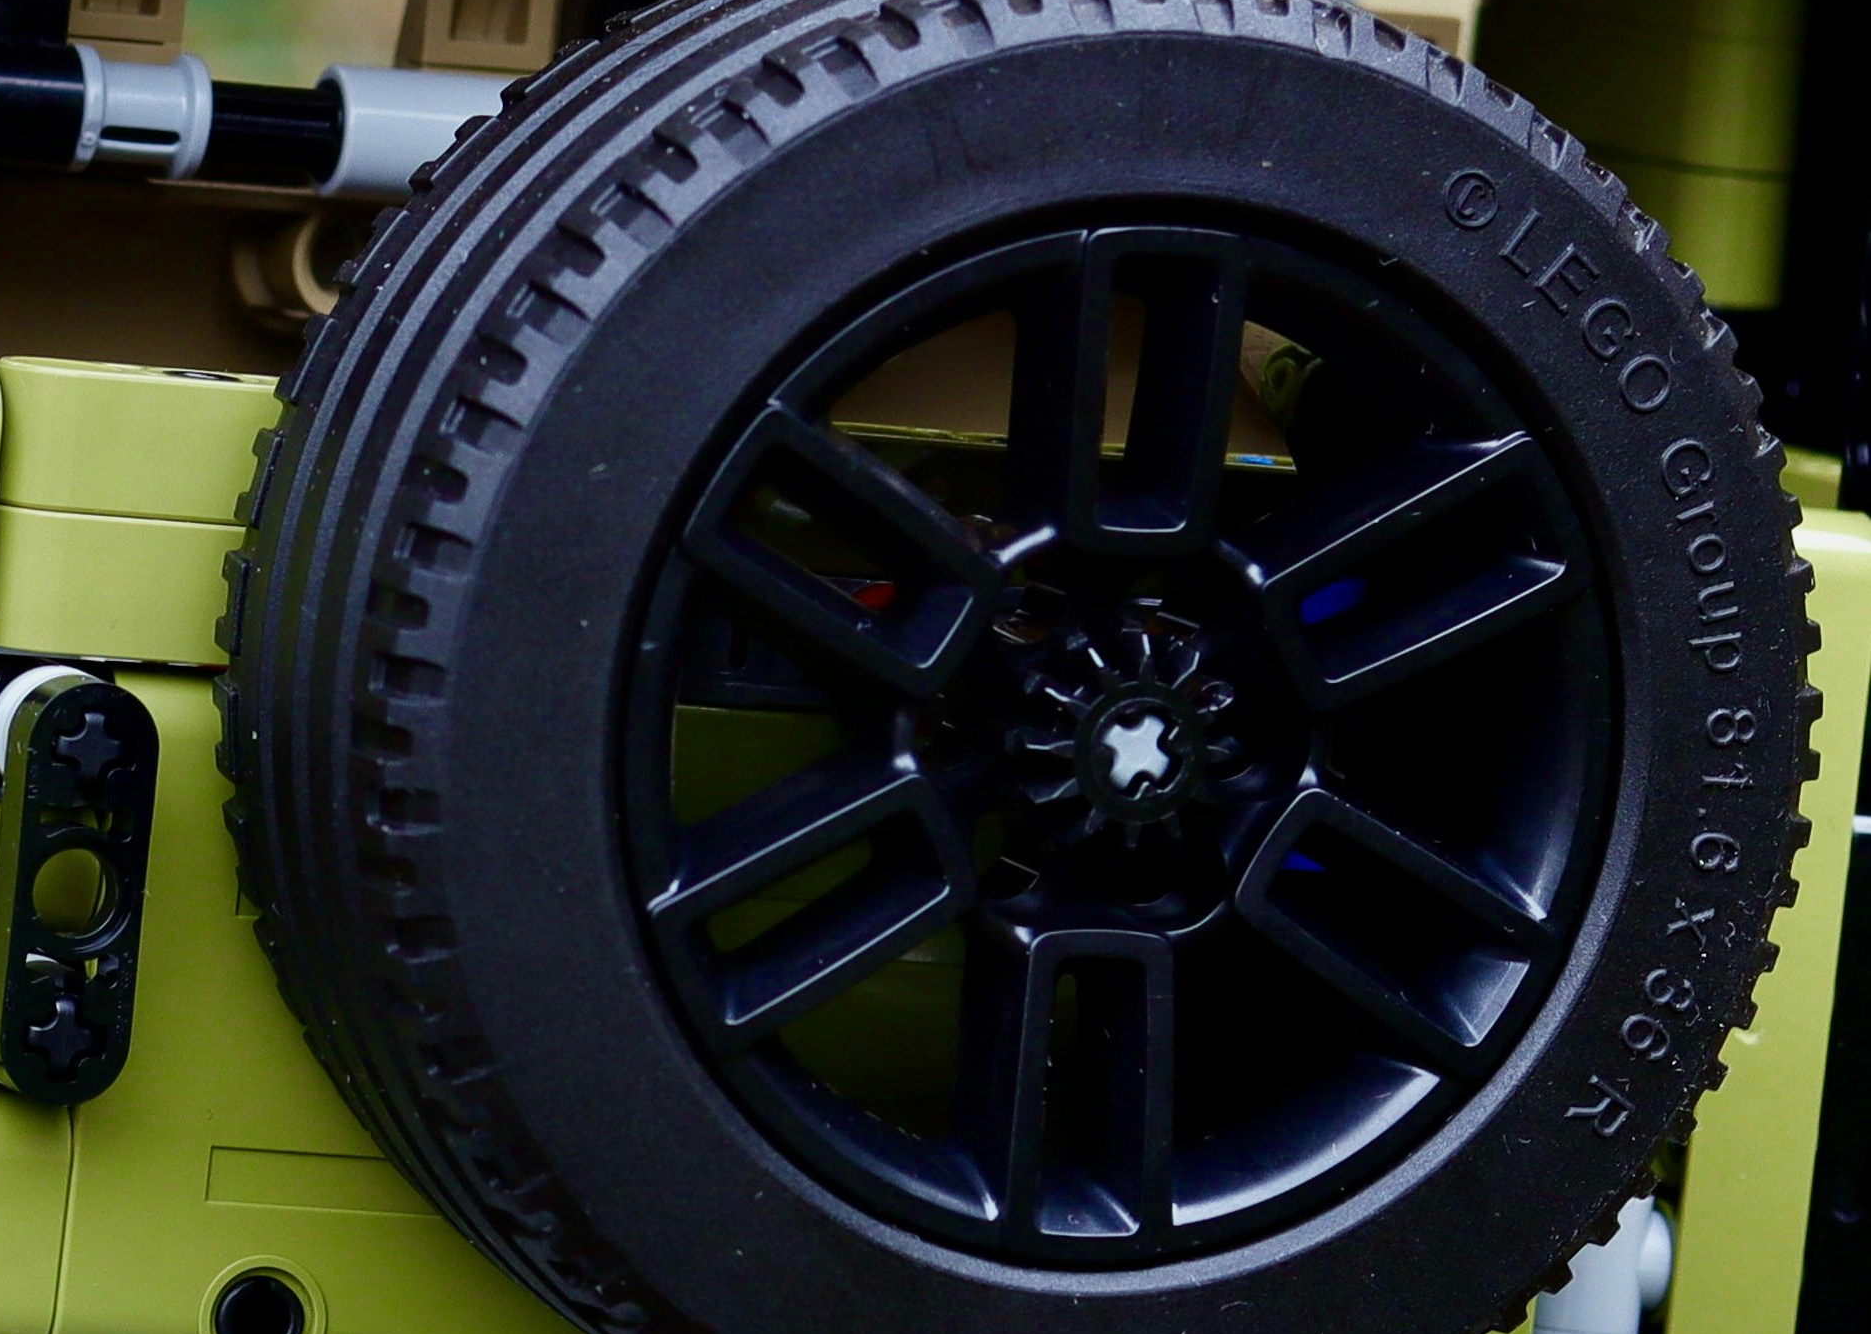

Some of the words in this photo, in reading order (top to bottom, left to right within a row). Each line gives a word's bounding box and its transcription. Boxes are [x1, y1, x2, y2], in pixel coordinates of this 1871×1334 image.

[1661, 437, 1743, 674] Group
[1690, 707, 1757, 874] 81.6
[1563, 1074, 1635, 1138] R
